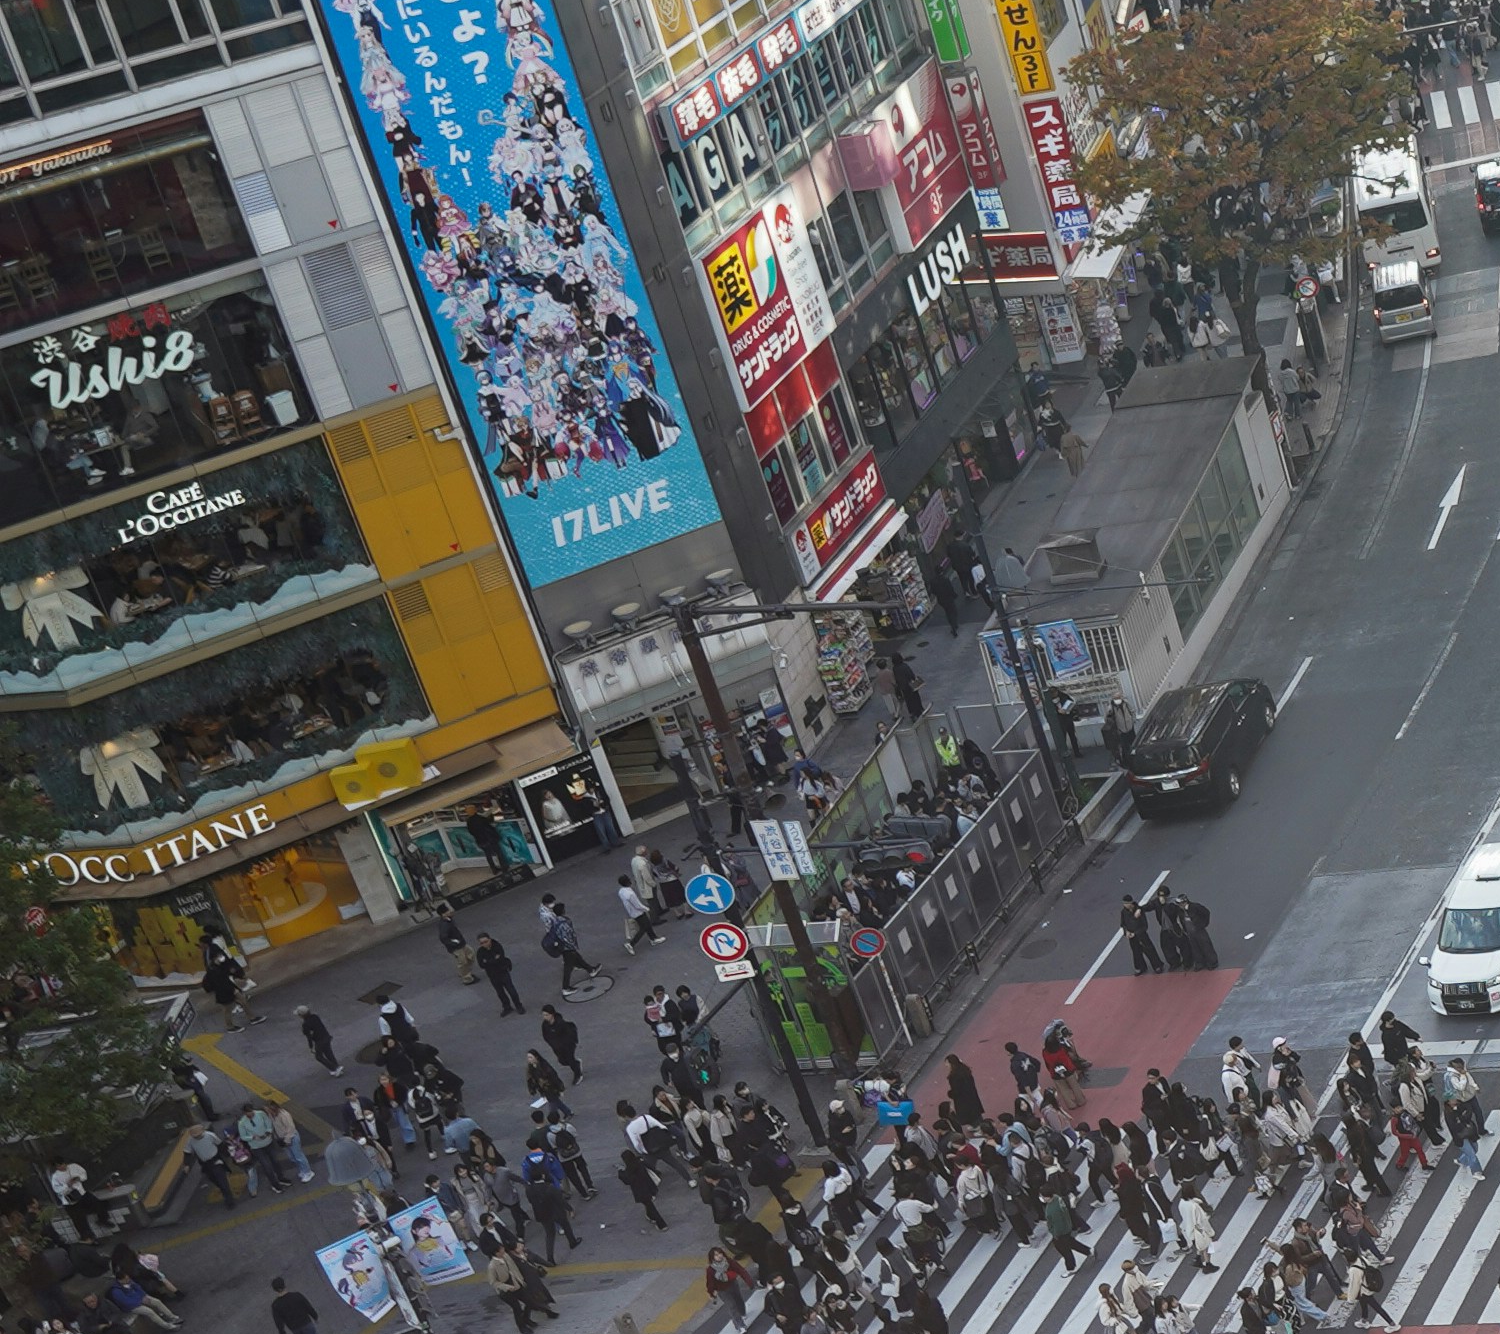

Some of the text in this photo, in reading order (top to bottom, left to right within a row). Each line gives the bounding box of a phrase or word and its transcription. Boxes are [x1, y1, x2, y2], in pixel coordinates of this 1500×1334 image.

[761, 23, 798, 70] 発毛
[1022, 56, 1041, 90] 3F
[676, 86, 717, 137] 薄毛
[667, 113, 757, 217] AGA
[904, 128, 948, 194] アコム
[962, 123, 987, 168] アコム
[1029, 105, 1080, 209] スギ薬局
[932, 184, 945, 215] 3F
[907, 222, 972, 318] LUSH
[968, 244, 1054, 269] ギ薬局
[713, 253, 753, 327] 薬
[33, 326, 102, 364] 渋谷
[732, 329, 754, 357] DRUG
[757, 295, 792, 333] COSMETIC
[739, 313, 801, 390] サンドラッグ
[30, 329, 196, 410] Ushi8
[118, 488, 246, 544] L'OCCITANE
[147, 482, 205, 515] CAFÉ
[831, 462, 878, 527] サンドラッグ
